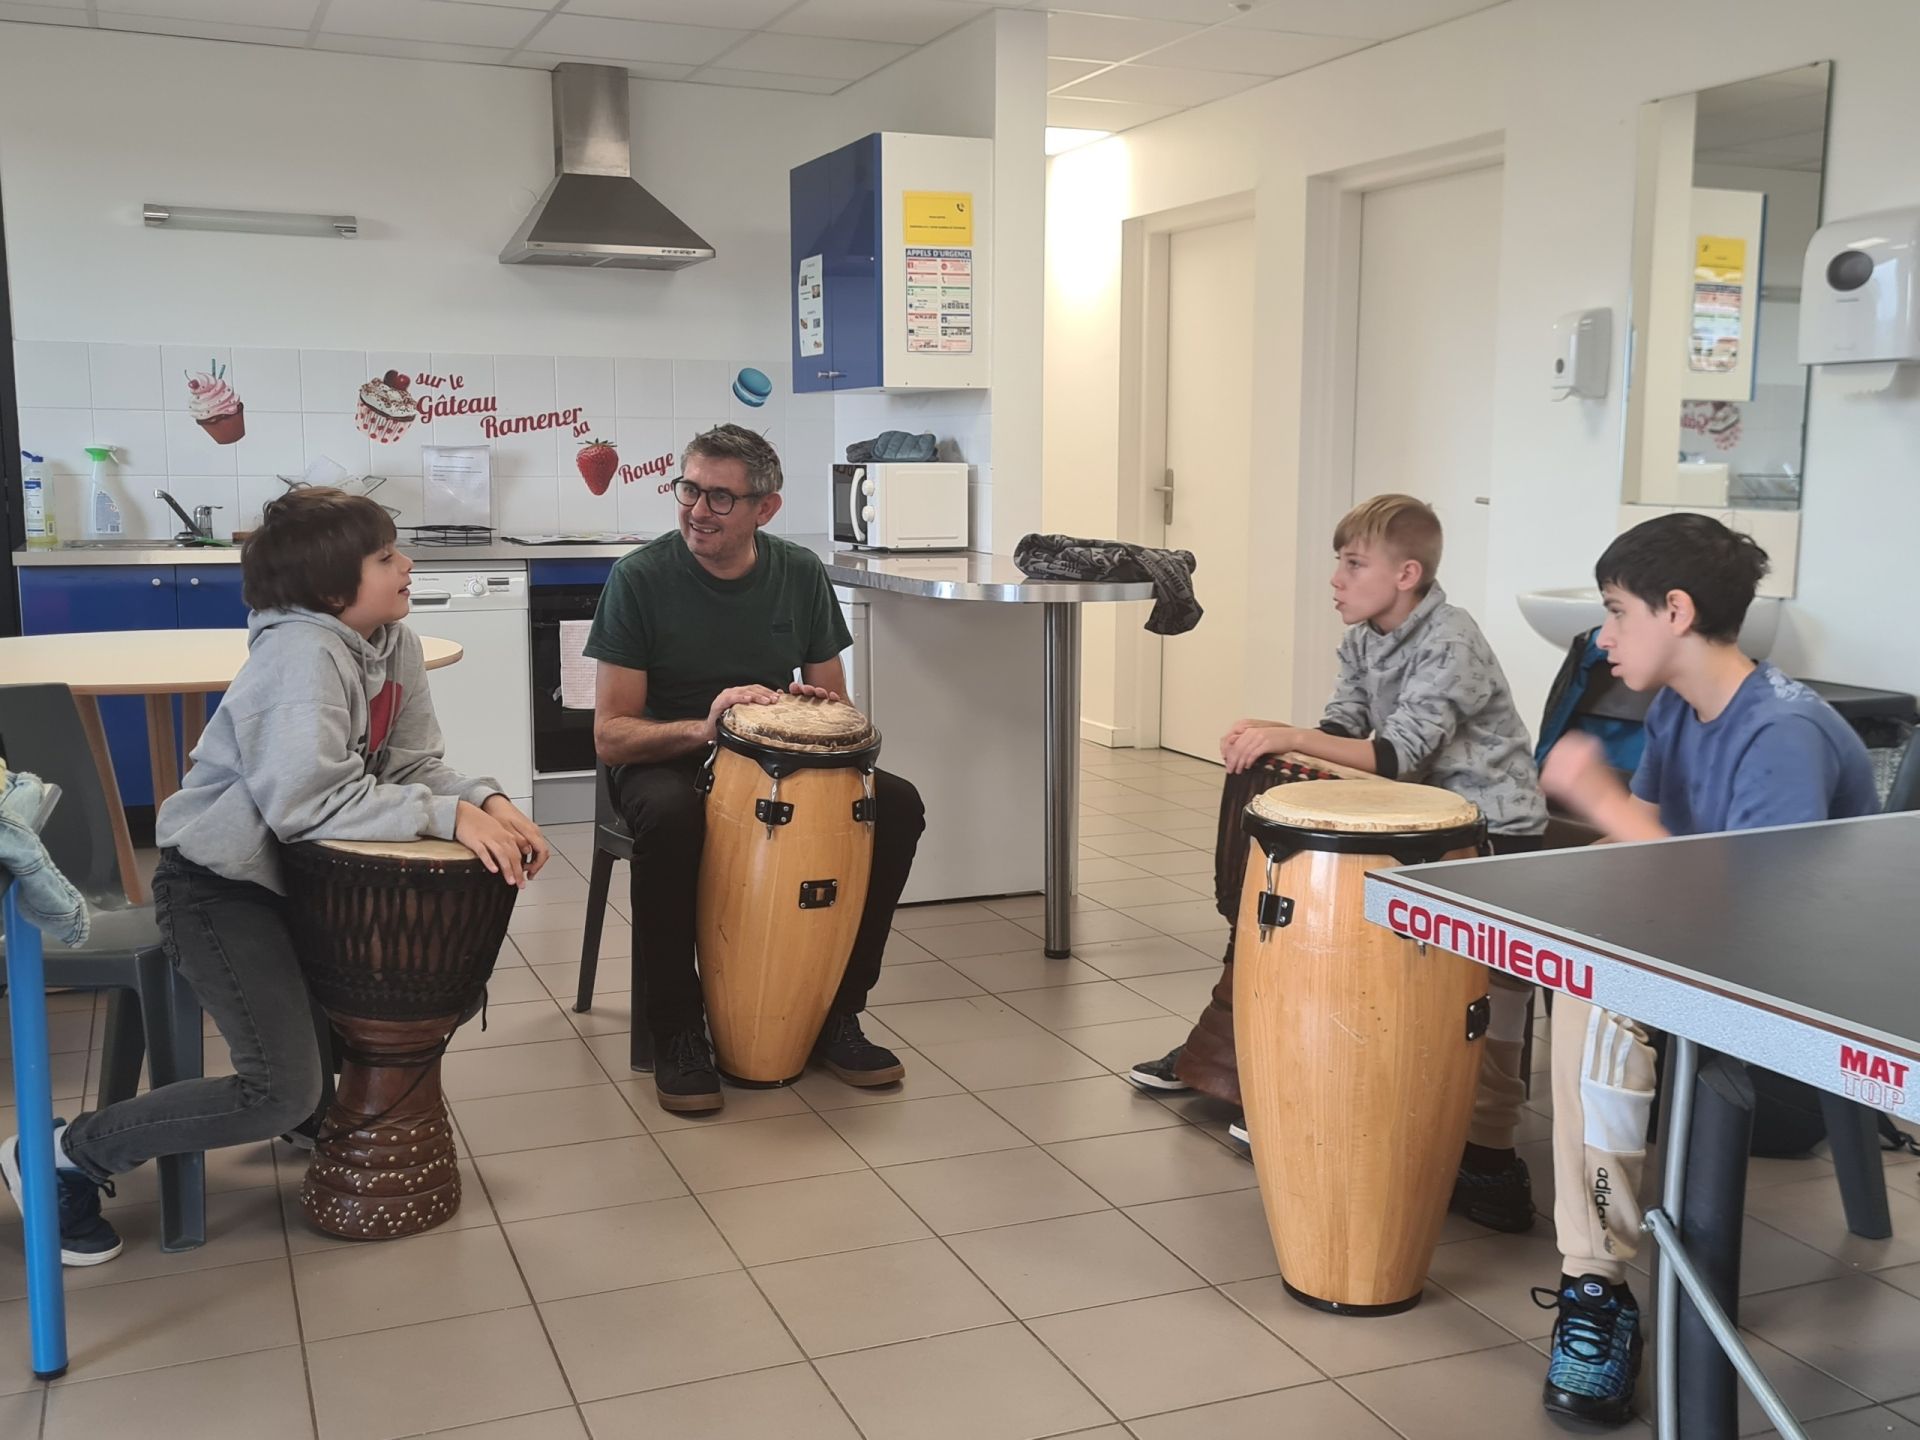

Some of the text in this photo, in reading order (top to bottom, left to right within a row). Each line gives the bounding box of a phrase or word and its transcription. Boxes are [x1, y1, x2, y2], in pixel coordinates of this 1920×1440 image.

[906, 249, 932, 257] APPELS
[415, 372, 464, 390] sur le
[416, 394, 498, 424] Gâteau
[480, 407, 583, 439] Ramener
[572, 420, 590, 438] sa
[618, 453, 674, 484] Rouge
[1388, 898, 1593, 1000] cornilleau
[1840, 1044, 1910, 1088] MAT
[1840, 1069, 1906, 1111] TOP
